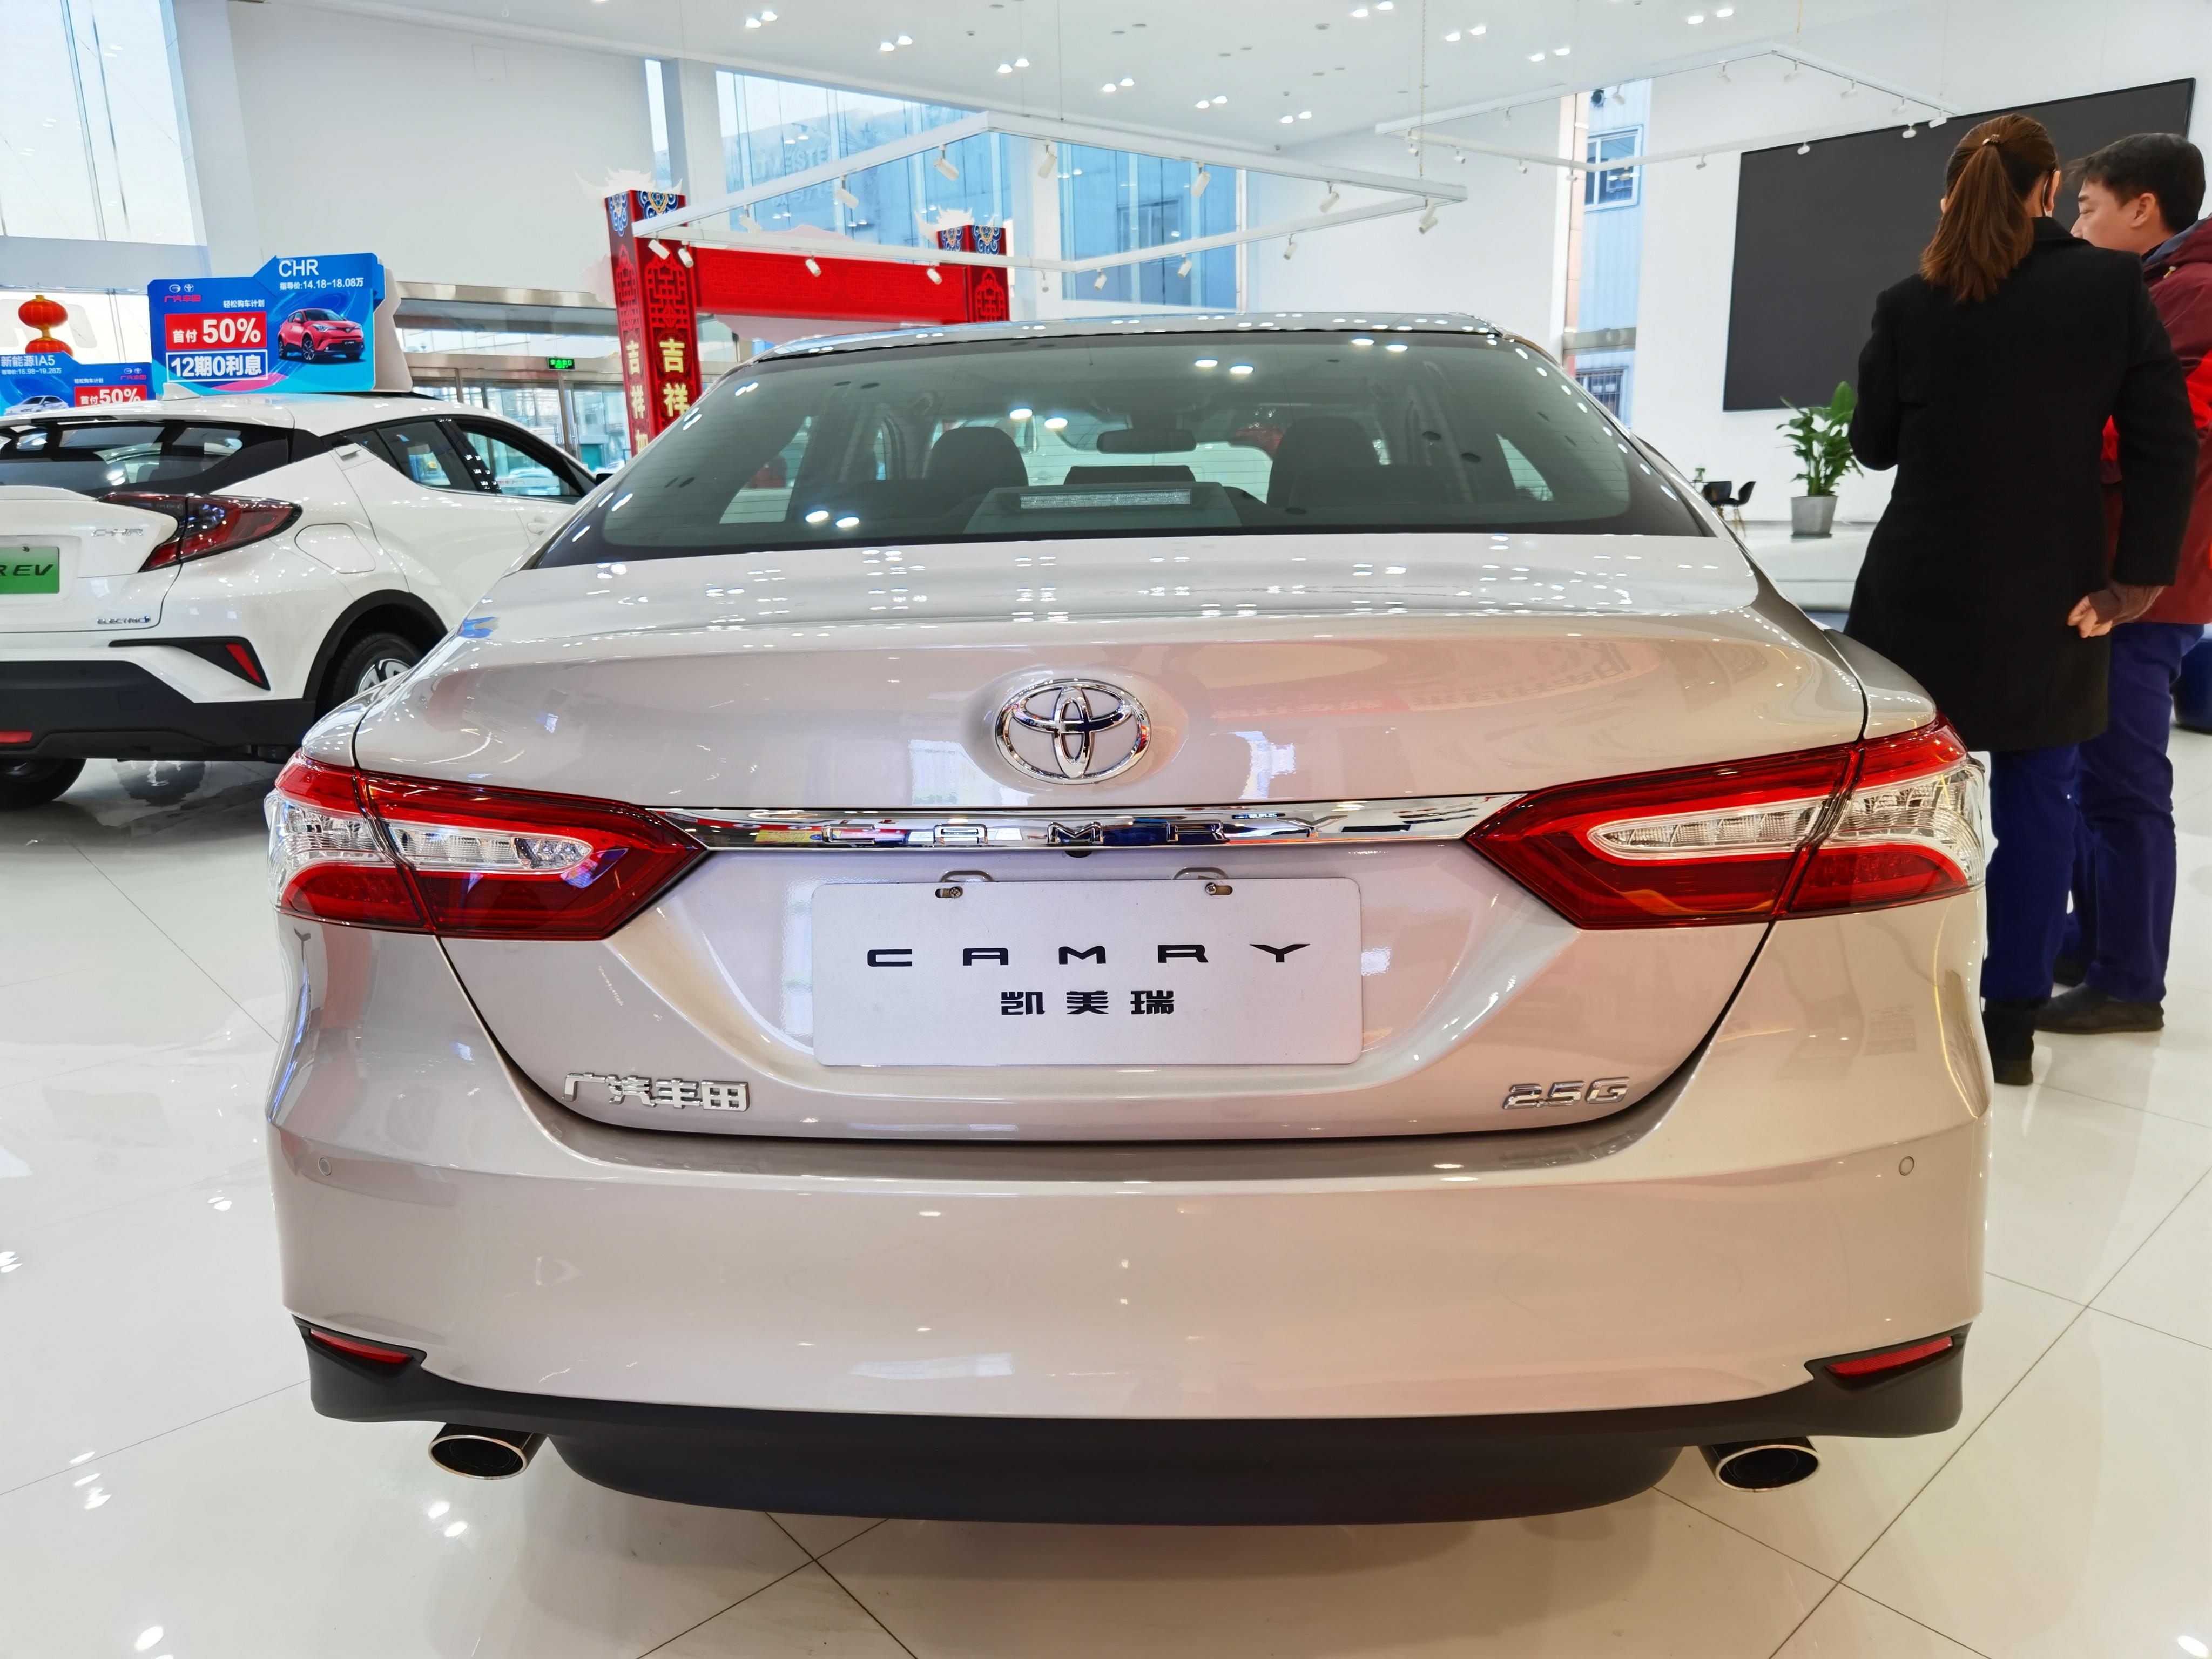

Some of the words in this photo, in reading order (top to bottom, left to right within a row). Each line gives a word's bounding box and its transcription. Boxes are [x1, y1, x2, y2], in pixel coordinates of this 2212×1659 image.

[279, 259, 319, 277] CHR
[223, 299, 265, 308] 轻松购车计划
[171, 354, 262, 377] 12期0利息
[659, 338, 690, 417] 吉祥
[821, 815, 1348, 845] CAMRY
[867, 943, 1311, 967] CAMRY
[1000, 989, 1175, 1016] 凯美瑞
[562, 1071, 750, 1112] 广汽丰田
